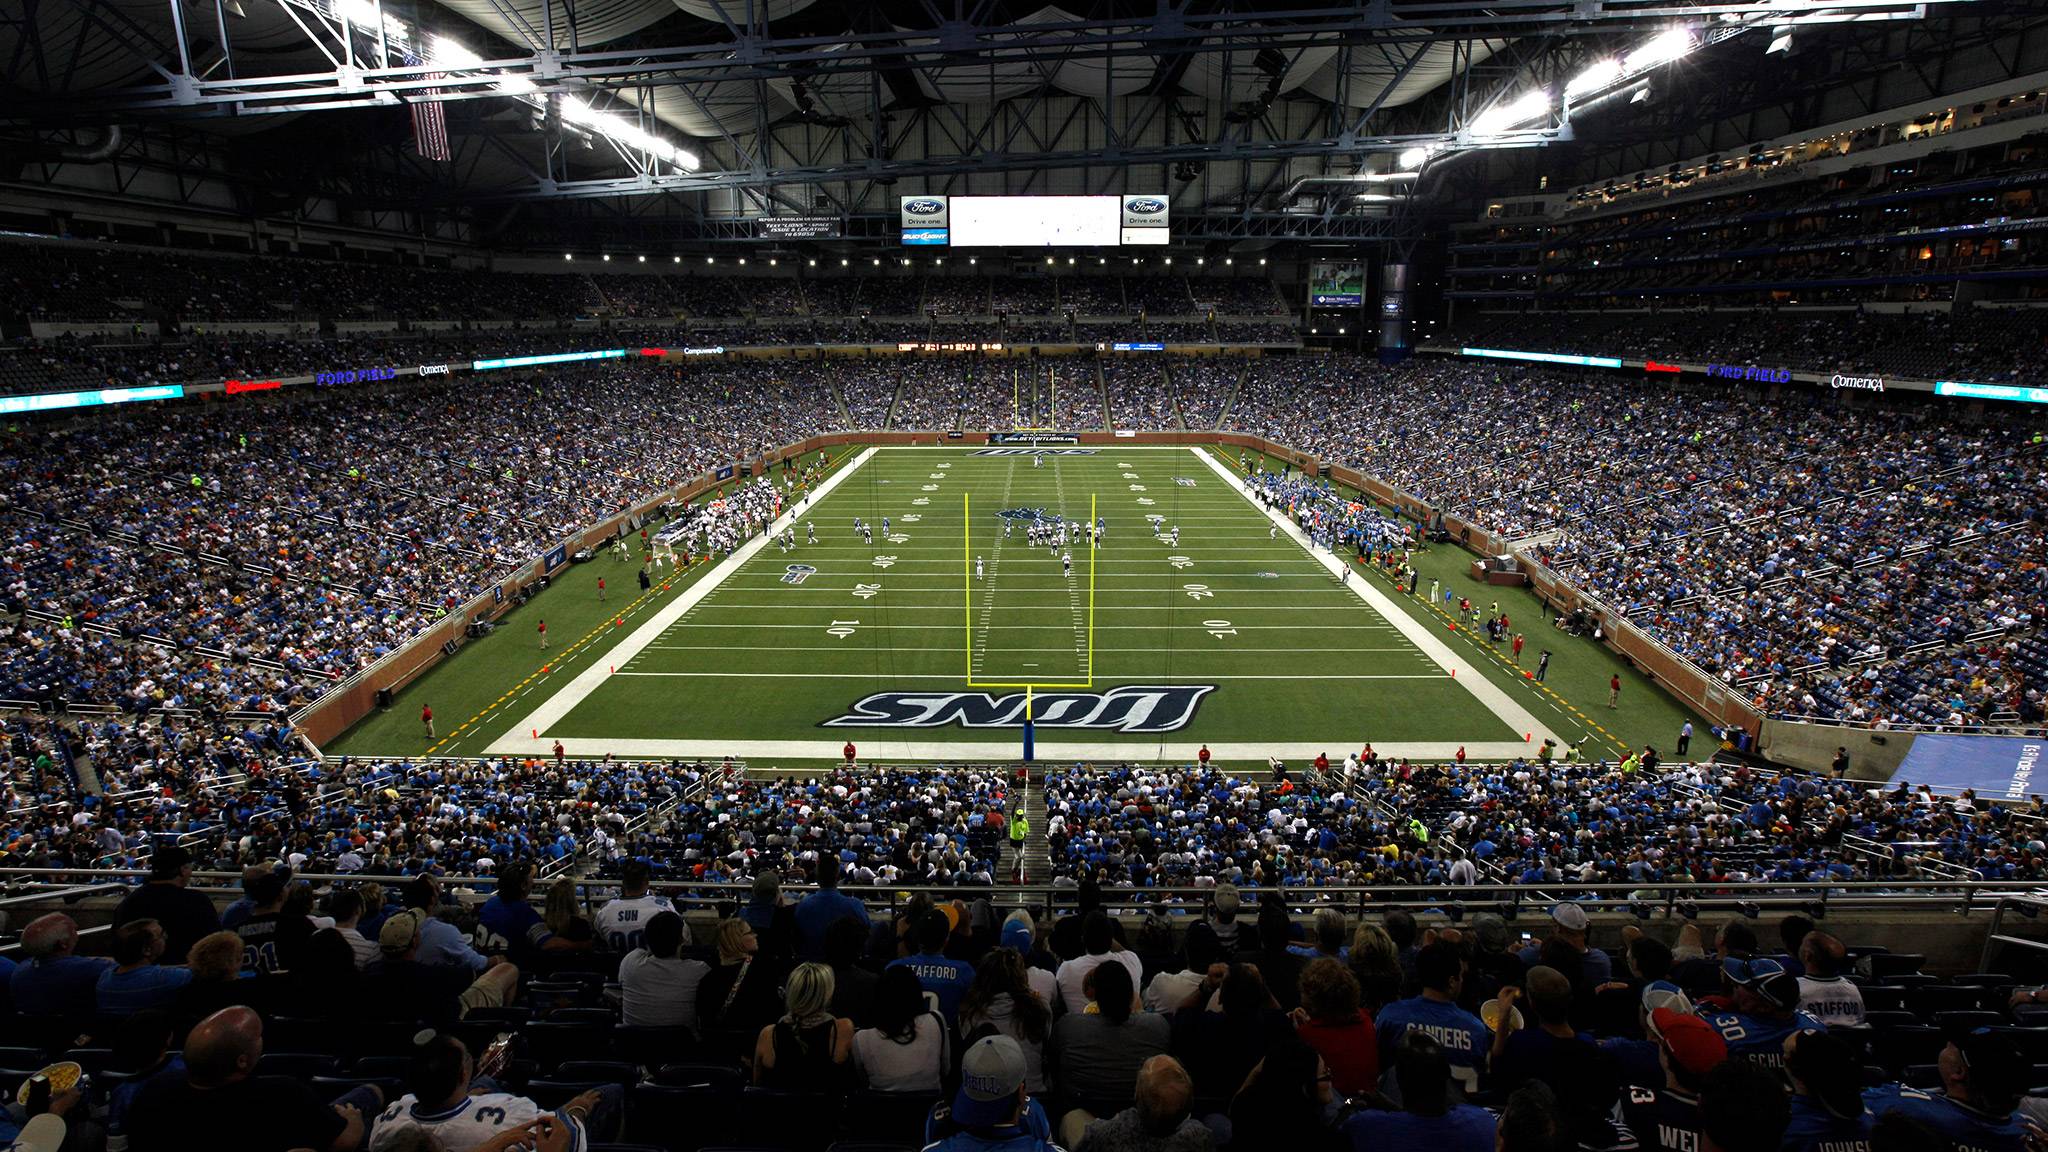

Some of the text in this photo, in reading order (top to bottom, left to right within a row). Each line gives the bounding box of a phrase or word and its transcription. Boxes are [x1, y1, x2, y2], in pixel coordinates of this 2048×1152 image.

[911, 201, 937, 212] Ford
[1133, 201, 1158, 211] Ford
[316, 368, 395, 386] FORD FIELD
[1707, 364, 1792, 384] FORD FIELD
[852, 583, 881, 597] 20
[1183, 584, 1214, 598] 20
[826, 620, 860, 636] 10
[1203, 620, 1238, 636] 10
[819, 684, 1215, 733] LIONS
[906, 964, 957, 980] TAFFORD
[1715, 1016, 1746, 1041] 30
[475, 1106, 506, 1125] 3
